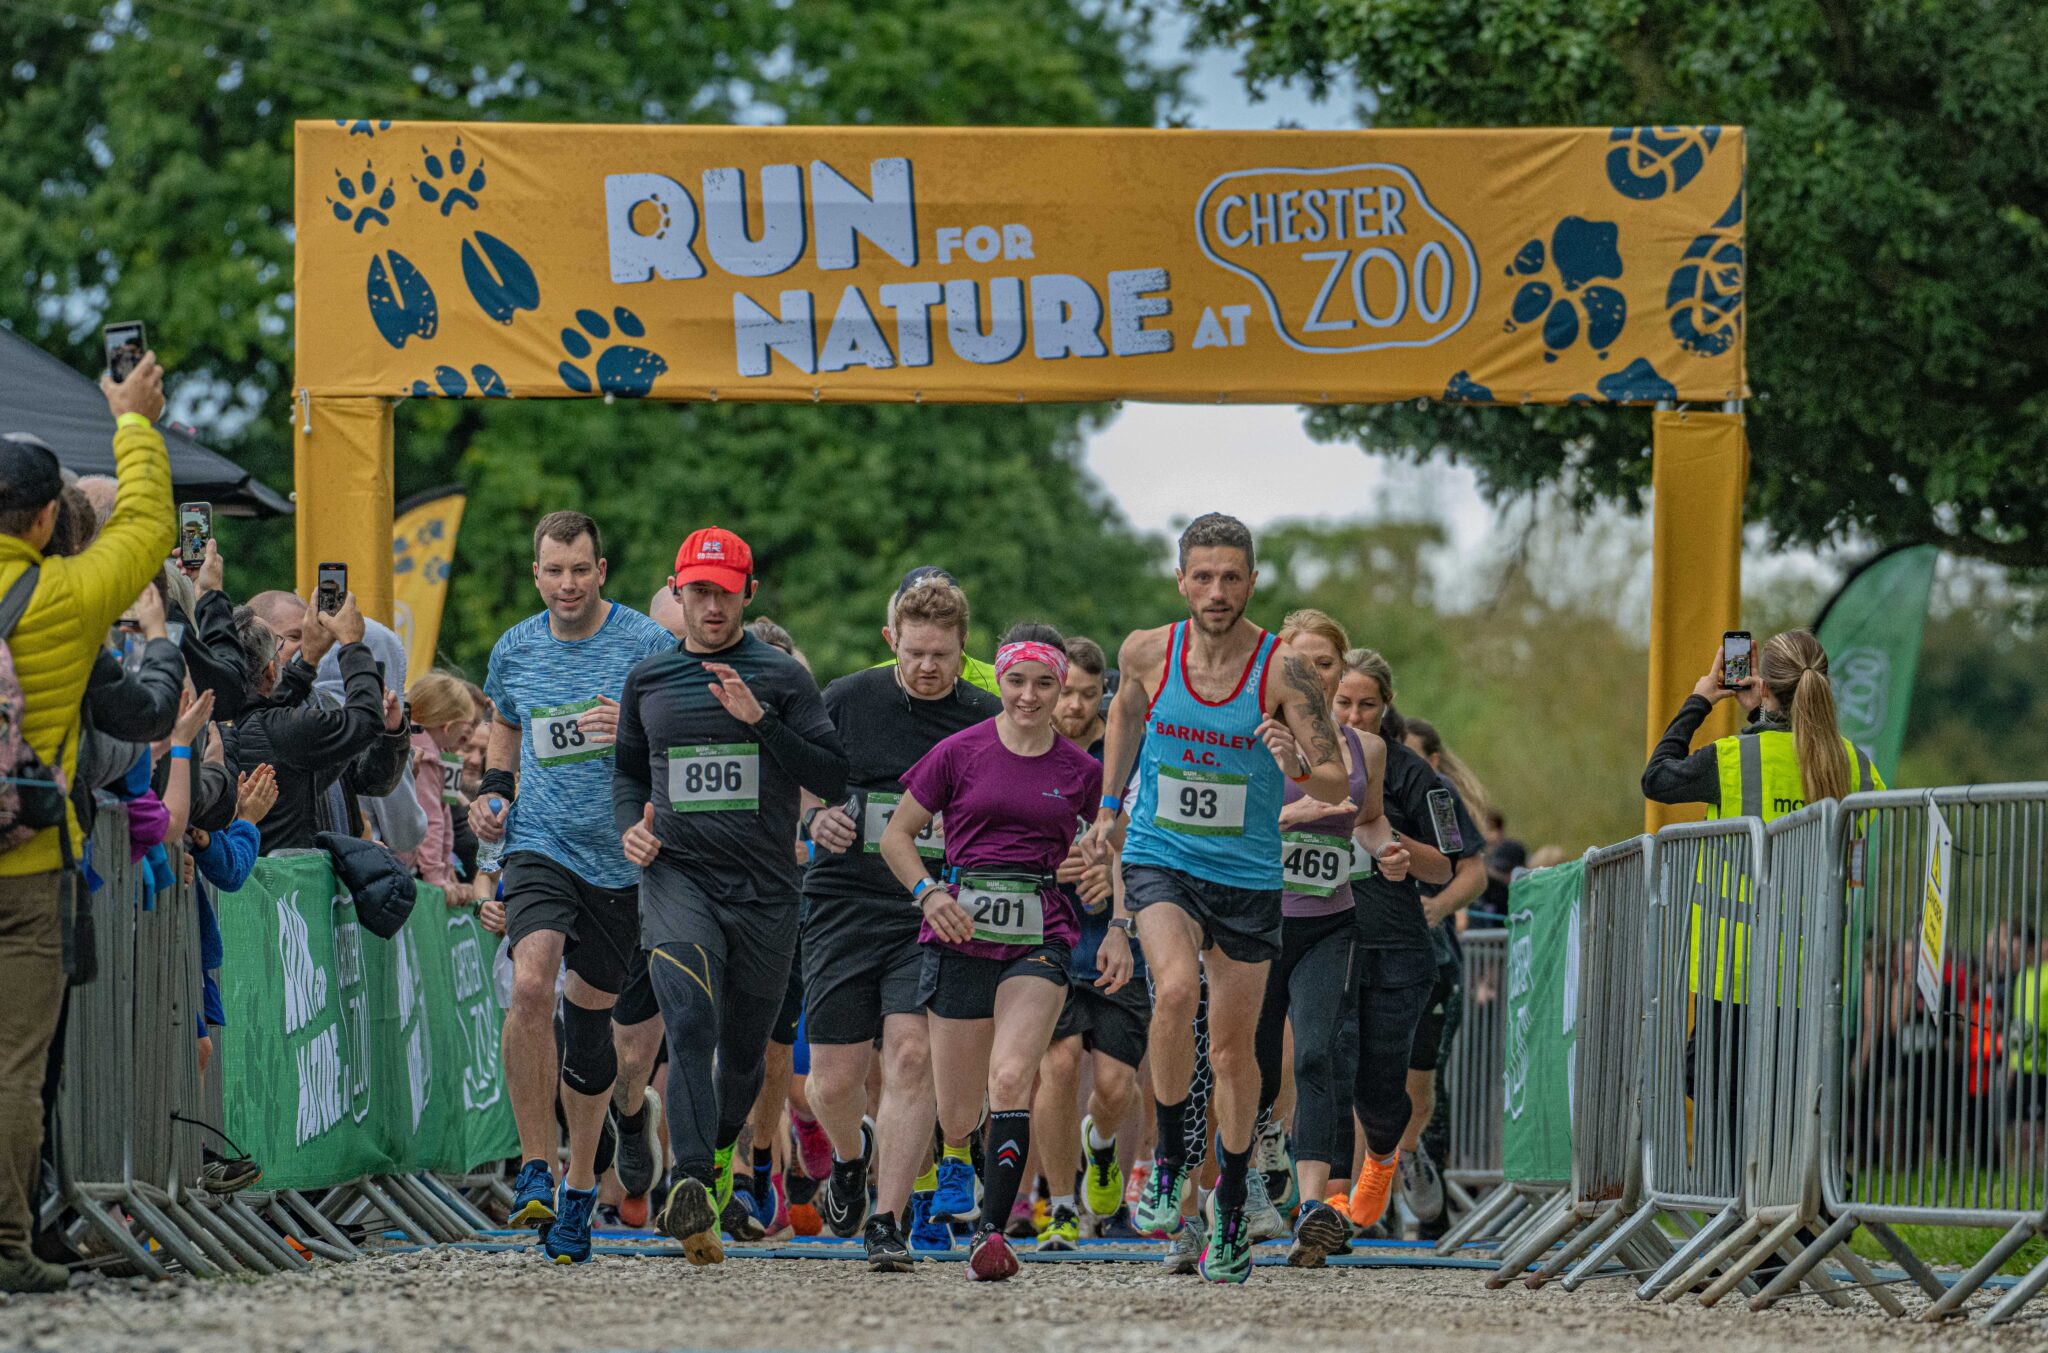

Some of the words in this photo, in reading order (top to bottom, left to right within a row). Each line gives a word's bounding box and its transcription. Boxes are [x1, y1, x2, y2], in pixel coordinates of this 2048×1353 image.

[604, 157, 918, 284] RUN
[936, 223, 1035, 264] FOR
[1216, 186, 1406, 247] CHESTER
[1301, 241, 1455, 332] ZOO
[733, 268, 1175, 376] NATURE
[1192, 305, 1251, 348] AT
[549, 719, 586, 750] 83
[1156, 721, 1258, 750] BARNSLEY
[1182, 748, 1222, 768] A.C.
[685, 760, 742, 793] 896
[1179, 786, 1218, 819] 93
[1283, 847, 1340, 881] 469
[973, 895, 1024, 927] 201
